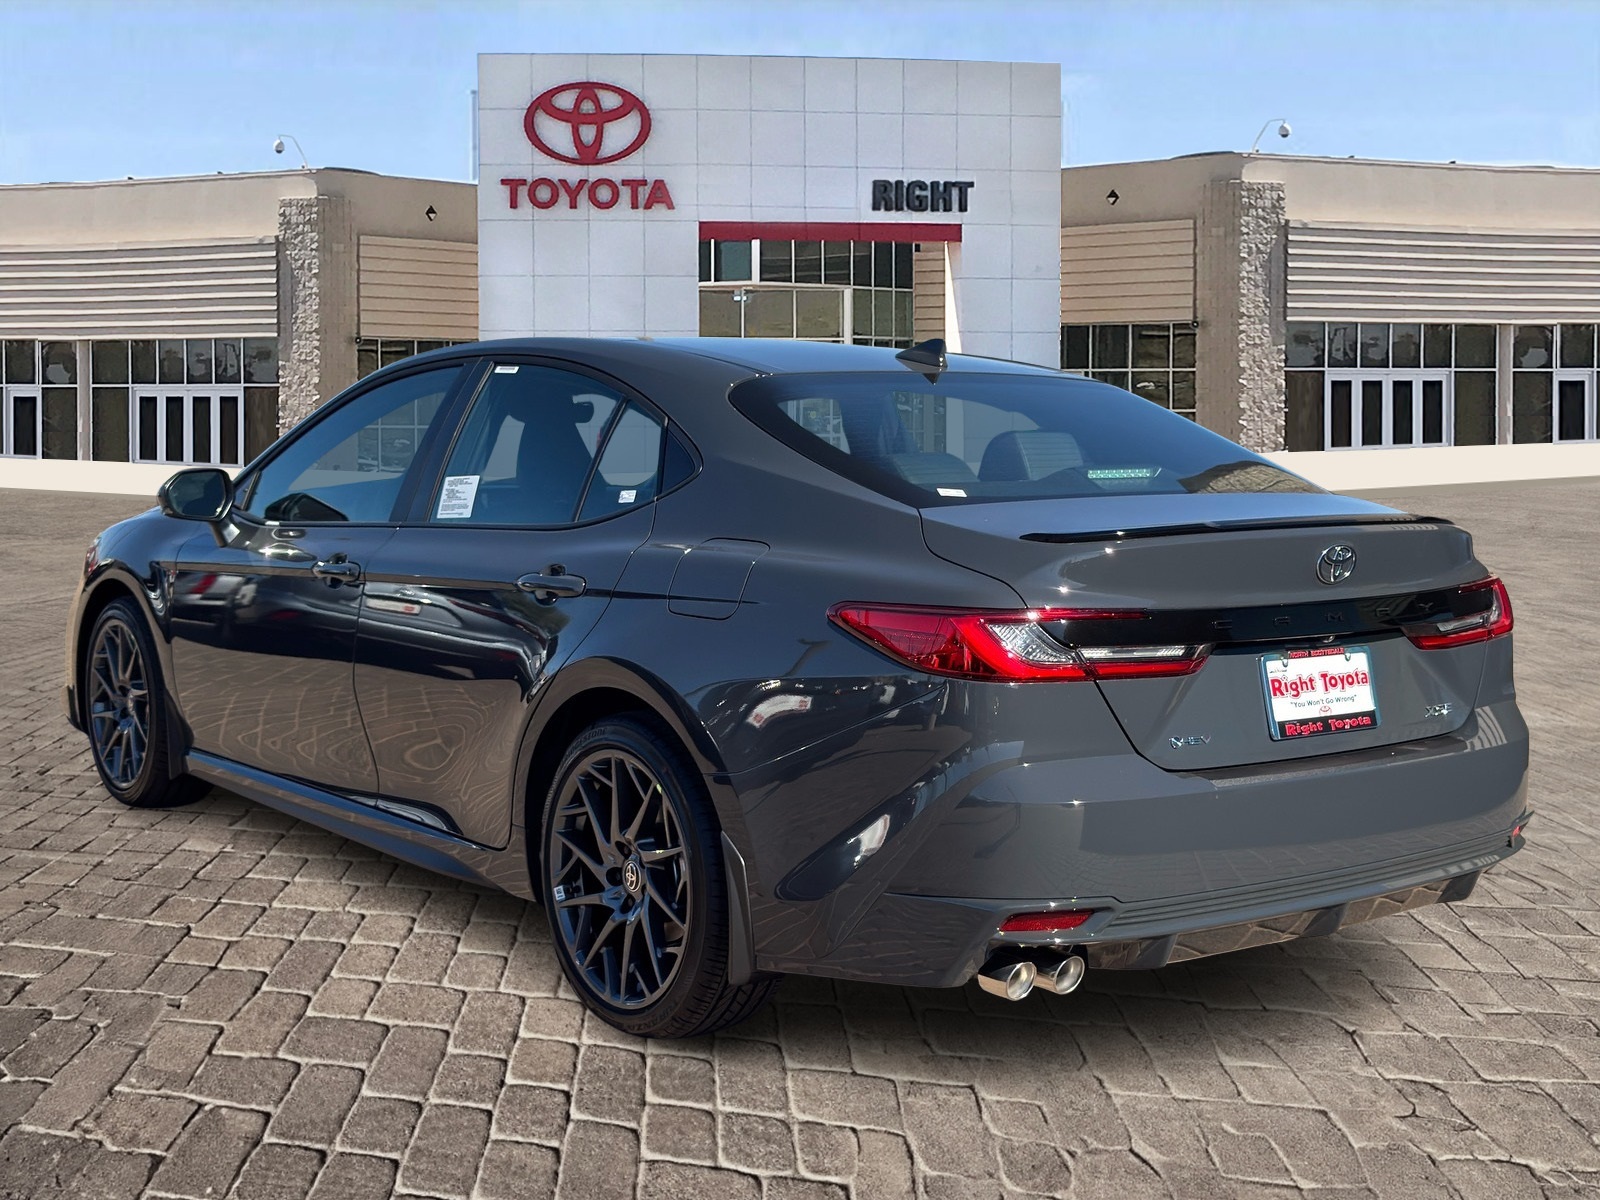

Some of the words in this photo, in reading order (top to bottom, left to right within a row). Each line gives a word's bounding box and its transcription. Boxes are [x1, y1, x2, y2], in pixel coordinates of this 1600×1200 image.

[500, 178, 675, 210] TOYOTA
[871, 179, 975, 212] RIGHT
[1269, 675, 1316, 698] Right
[1320, 670, 1369, 692] Toyota
[1335, 694, 1357, 703] Wrong"
[1284, 721, 1323, 736] Right
[1328, 715, 1372, 731] Toyota
